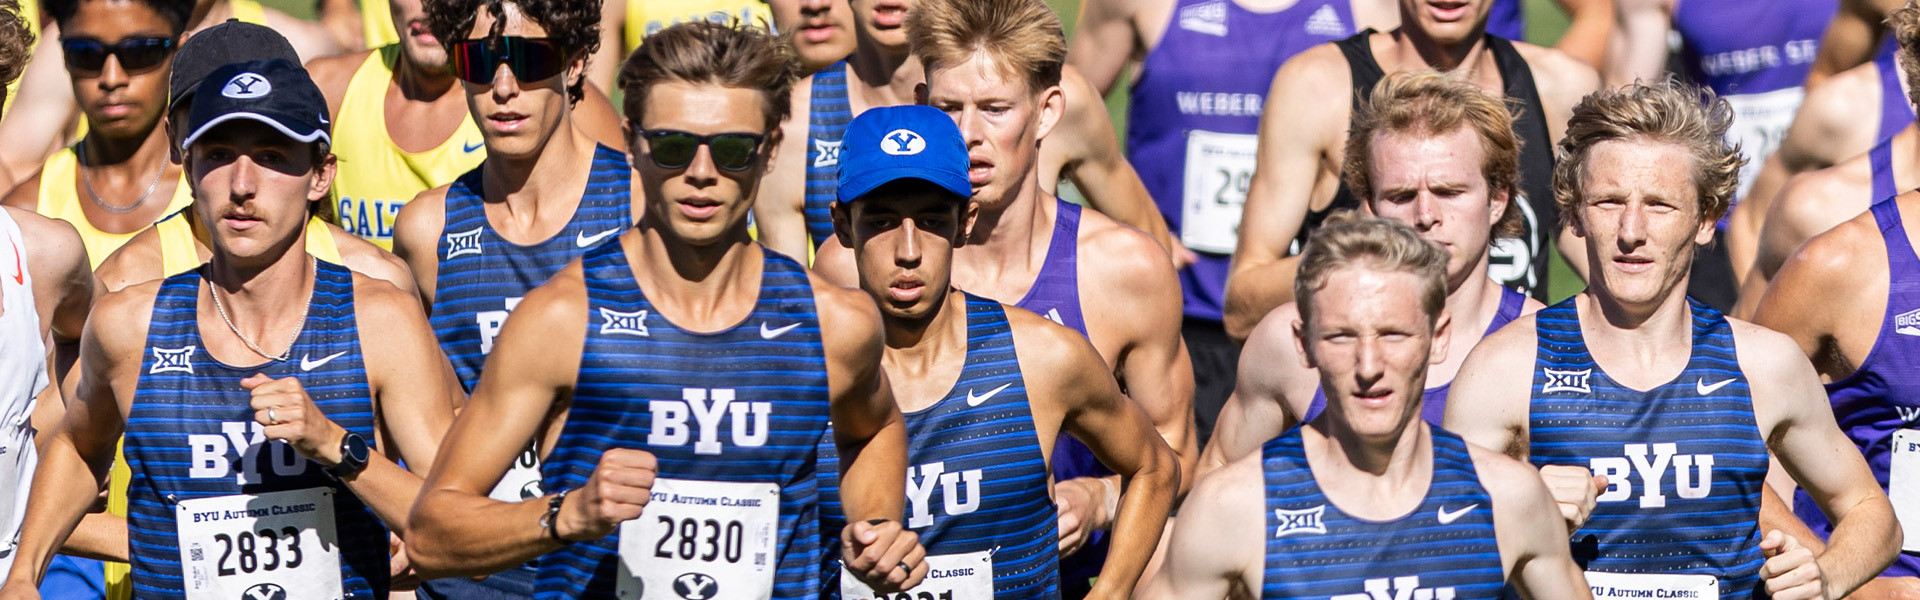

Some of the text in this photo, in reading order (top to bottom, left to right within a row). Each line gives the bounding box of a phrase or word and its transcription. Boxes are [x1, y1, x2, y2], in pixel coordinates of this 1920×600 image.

[229, 76, 262, 94] Y
[1177, 91, 1263, 116] WEBER
[888, 132, 917, 152] Y
[647, 387, 772, 454] BYU
[188, 421, 307, 486] BYU
[1590, 442, 1714, 509] BYU
[193, 511, 219, 523] BYU
[905, 461, 982, 529] YU
[214, 525, 303, 577] 2833
[654, 515, 743, 563] 2830
[678, 574, 713, 600] Y
